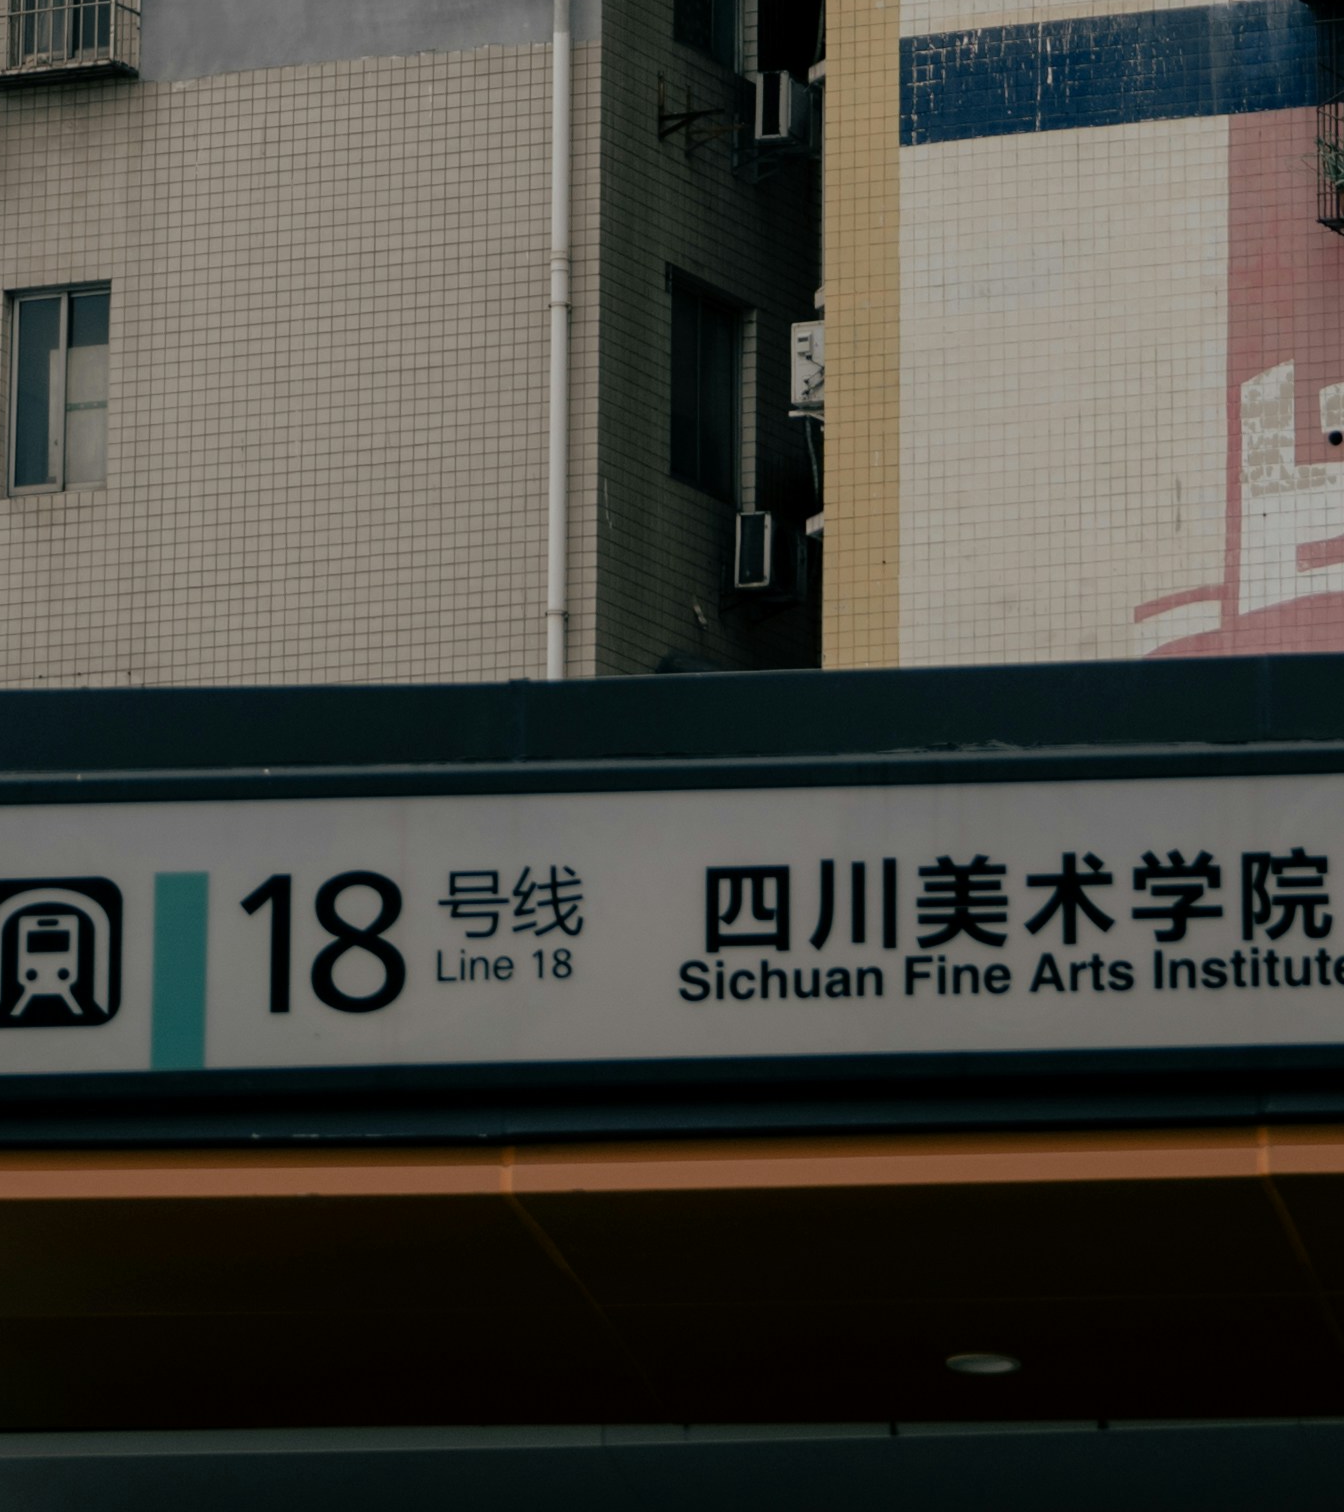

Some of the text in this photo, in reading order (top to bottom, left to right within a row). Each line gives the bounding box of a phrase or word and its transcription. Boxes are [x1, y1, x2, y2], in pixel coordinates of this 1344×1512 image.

[437, 864, 584, 941] 号线
[704, 845, 1334, 954] 四川美术学院
[240, 870, 407, 1014] 18
[436, 948, 574, 982] Line 18
[678, 958, 884, 1003] Sichuan
[904, 955, 1012, 996] Fine
[1029, 952, 1135, 993] Arts
